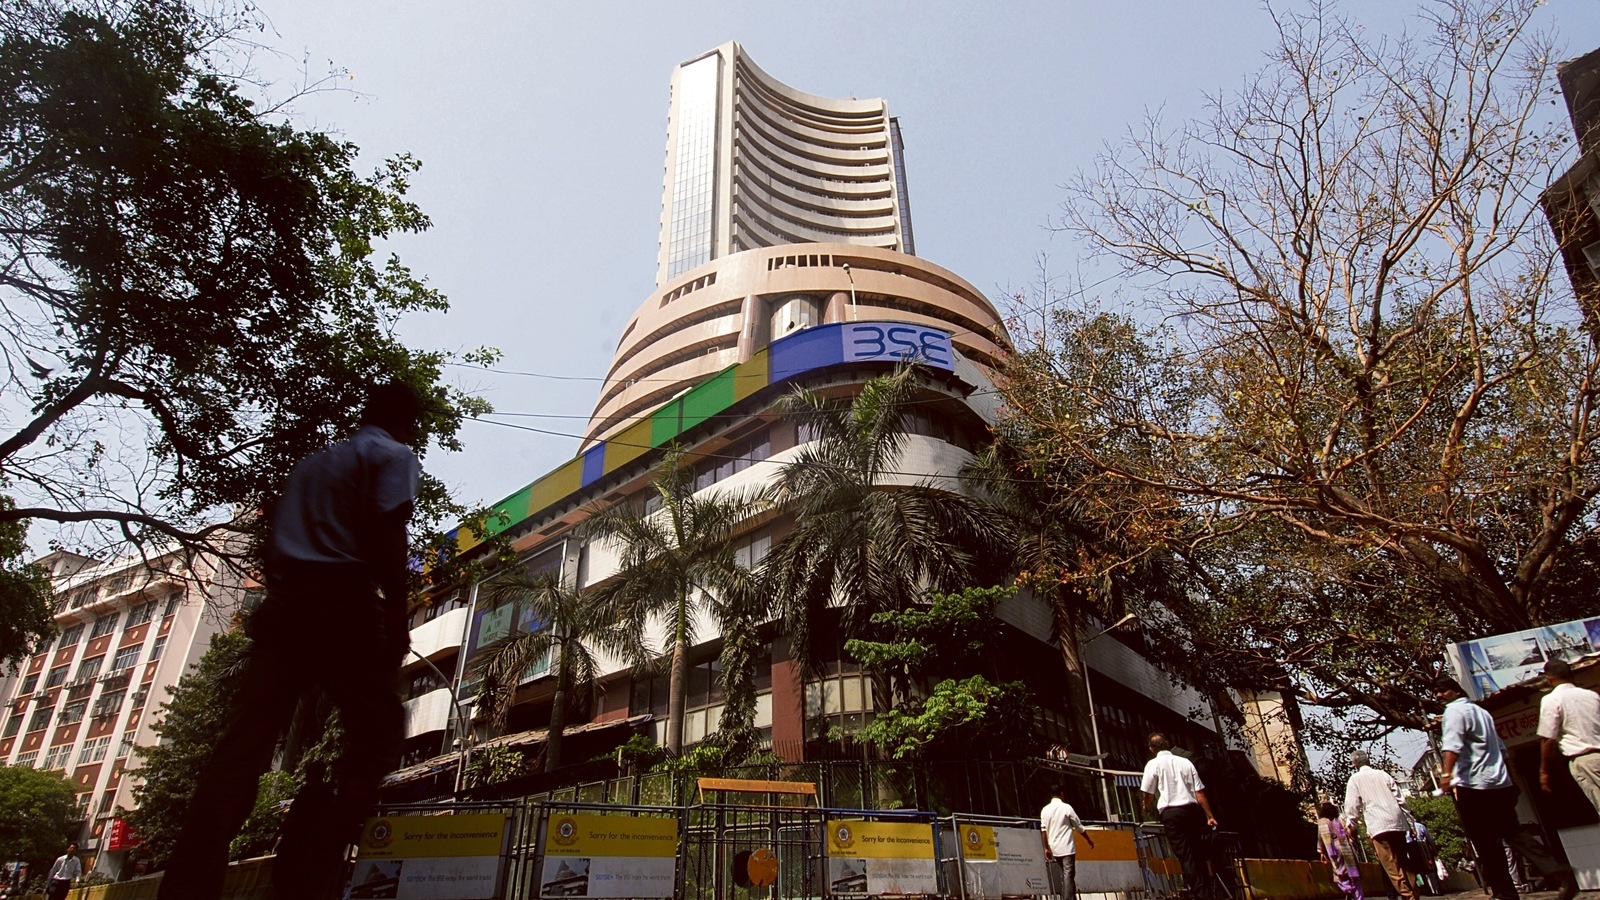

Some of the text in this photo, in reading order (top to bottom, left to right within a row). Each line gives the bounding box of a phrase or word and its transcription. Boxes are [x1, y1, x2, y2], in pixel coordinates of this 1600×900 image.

[852, 326, 949, 365] BSE
[403, 830, 498, 842] Sorry for the inconvenience
[589, 831, 674, 842] Sorry for the inconvenience
[861, 835, 930, 845] Sorry for the inconvenience
